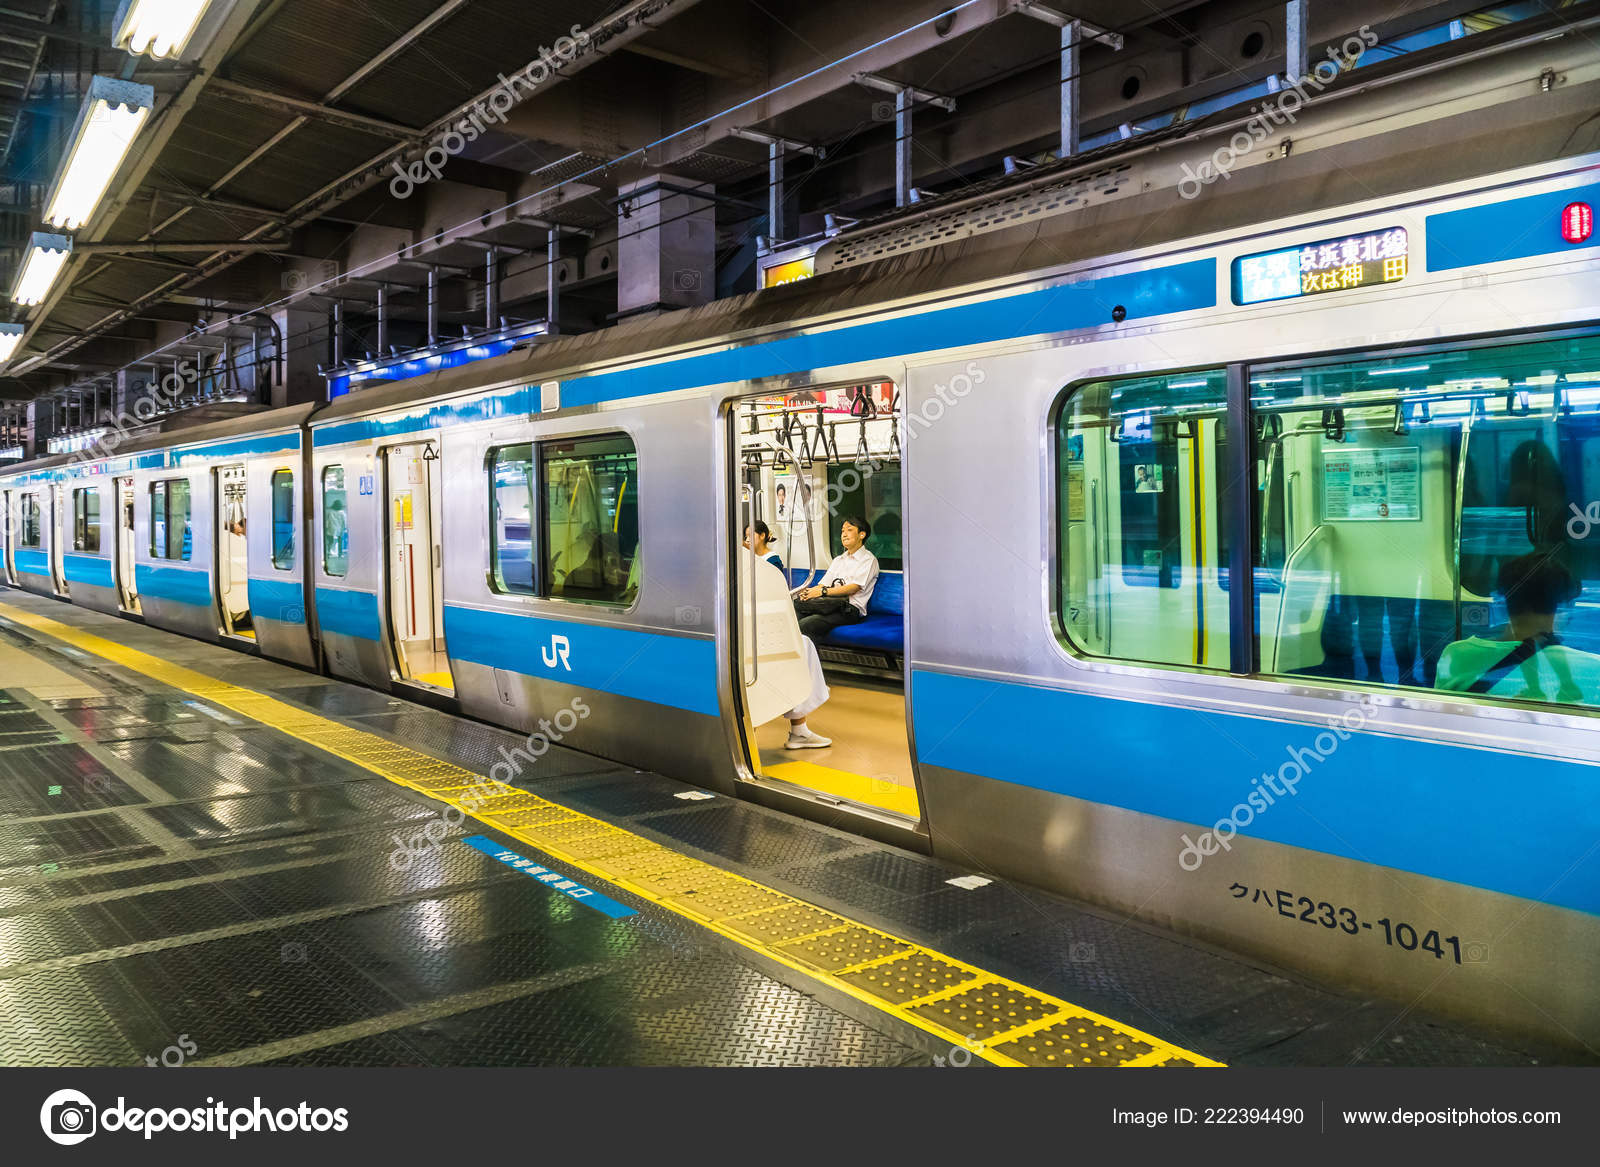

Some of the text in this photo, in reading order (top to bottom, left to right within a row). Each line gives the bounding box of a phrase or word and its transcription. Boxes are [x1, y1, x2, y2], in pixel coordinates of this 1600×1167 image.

[1300, 229, 1408, 271] 京浜東北線
[541, 634, 572, 672] JR
[1229, 882, 1462, 964] クハE233-1041
